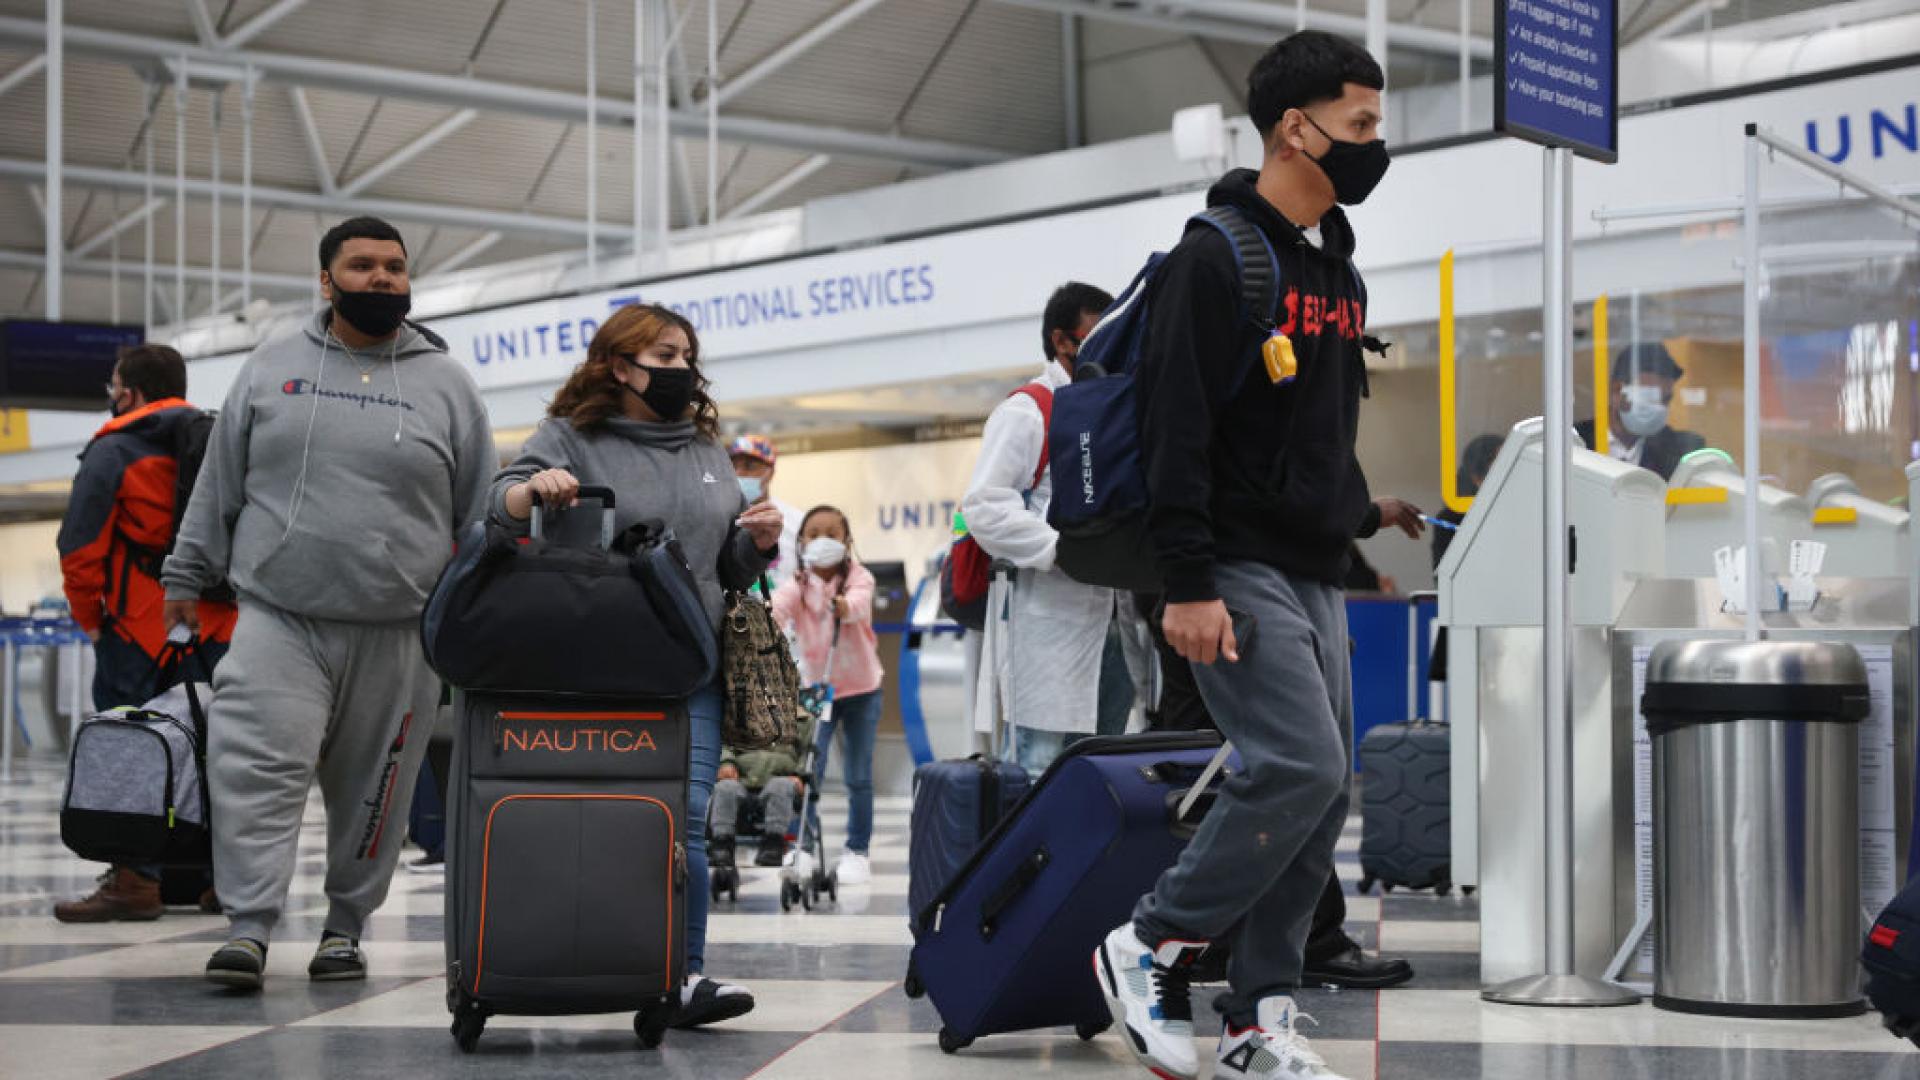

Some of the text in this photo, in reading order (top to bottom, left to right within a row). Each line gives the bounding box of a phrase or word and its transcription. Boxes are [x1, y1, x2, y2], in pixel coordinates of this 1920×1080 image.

[1533, 32, 1560, 53] already
[1560, 42, 1589, 61] checked
[1519, 51, 1546, 74] Prepaid
[1547, 64, 1583, 85] applicable
[1518, 79, 1604, 118] Have your boarding pass
[1805, 103, 1918, 165] UN
[473, 265, 935, 365] UNITED DITIONAL SERVICES
[283, 378, 416, 411] Champion
[1083, 468, 1094, 503] NIKE
[502, 728, 658, 752] NAUTICA
